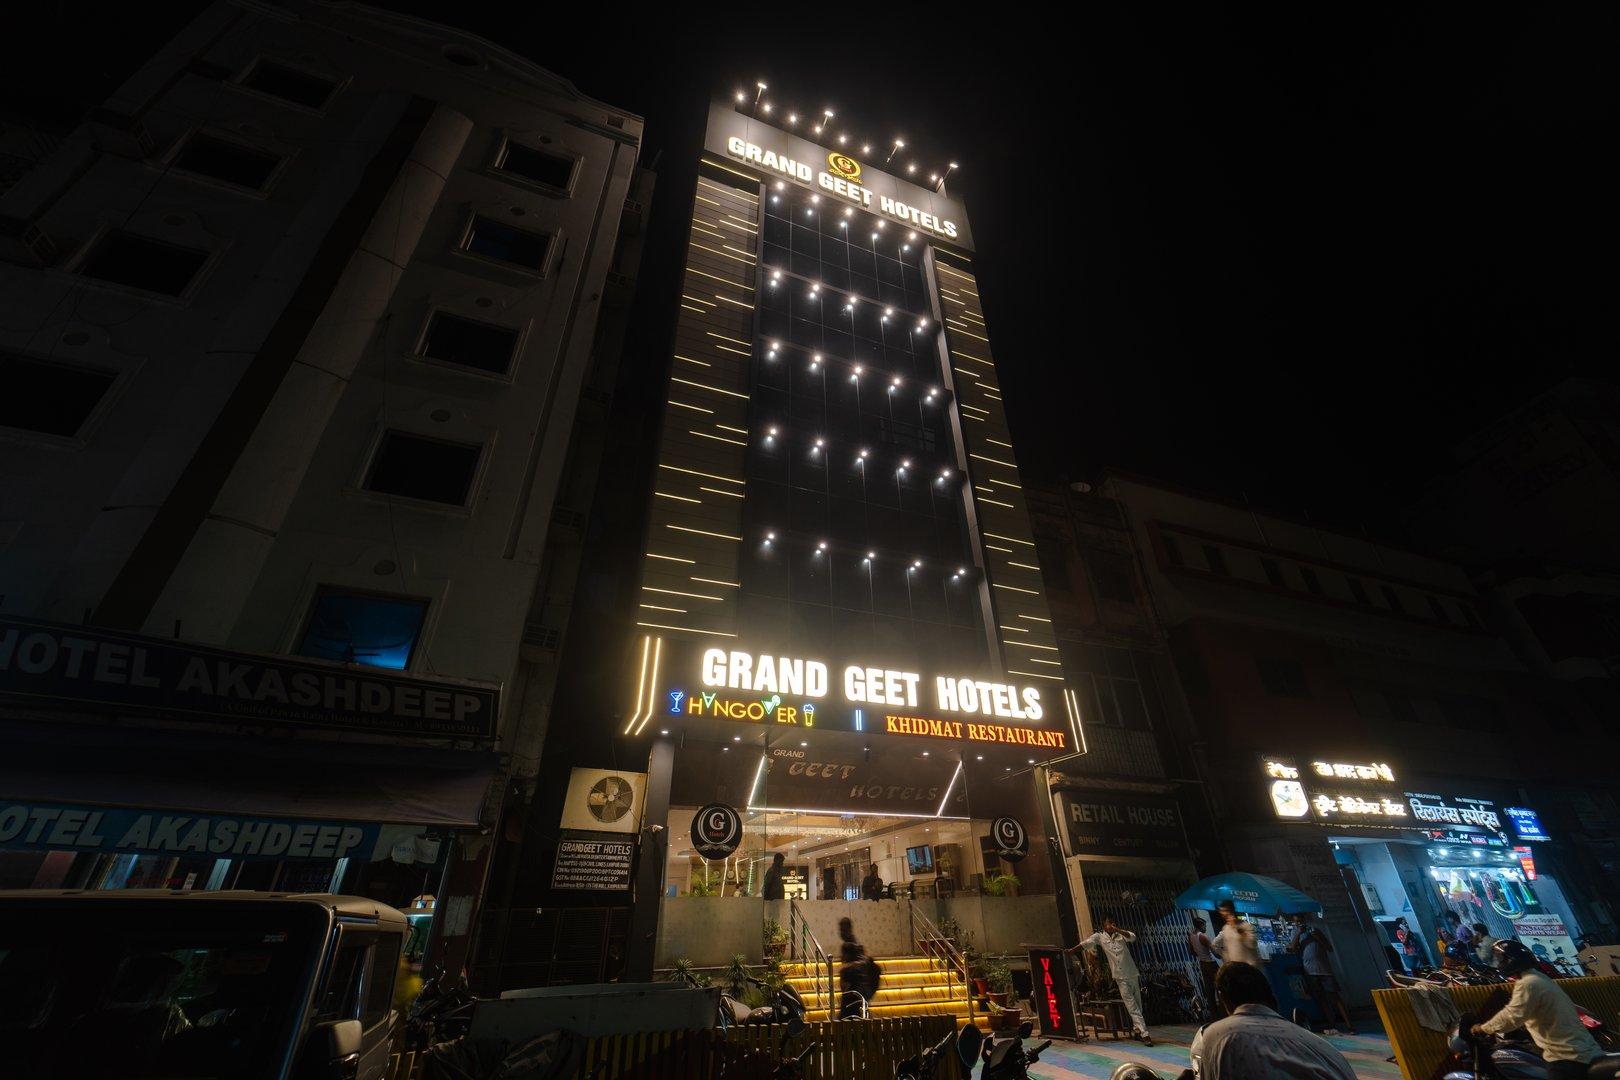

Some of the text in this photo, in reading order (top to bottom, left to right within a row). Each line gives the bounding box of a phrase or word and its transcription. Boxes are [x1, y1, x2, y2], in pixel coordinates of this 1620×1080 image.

[728, 136, 958, 239] GRAND GEET HOTELS
[175, 655, 481, 722] AKASHDEEP
[702, 647, 1044, 720] GRAND GEET HOTELS
[885, 714, 1065, 749] KHIDMAT RESTAURANT
[773, 749, 805, 759] GRAND
[788, 761, 856, 780] GEET
[709, 812, 726, 831] G
[1070, 803, 1177, 827] RETAIL HOUSE
[115, 814, 364, 858] AKASHDEEP
[603, 844, 632, 855] HOTELS
[1229, 889, 1259, 898] TECNO
[1040, 957, 1060, 1028] VALET
